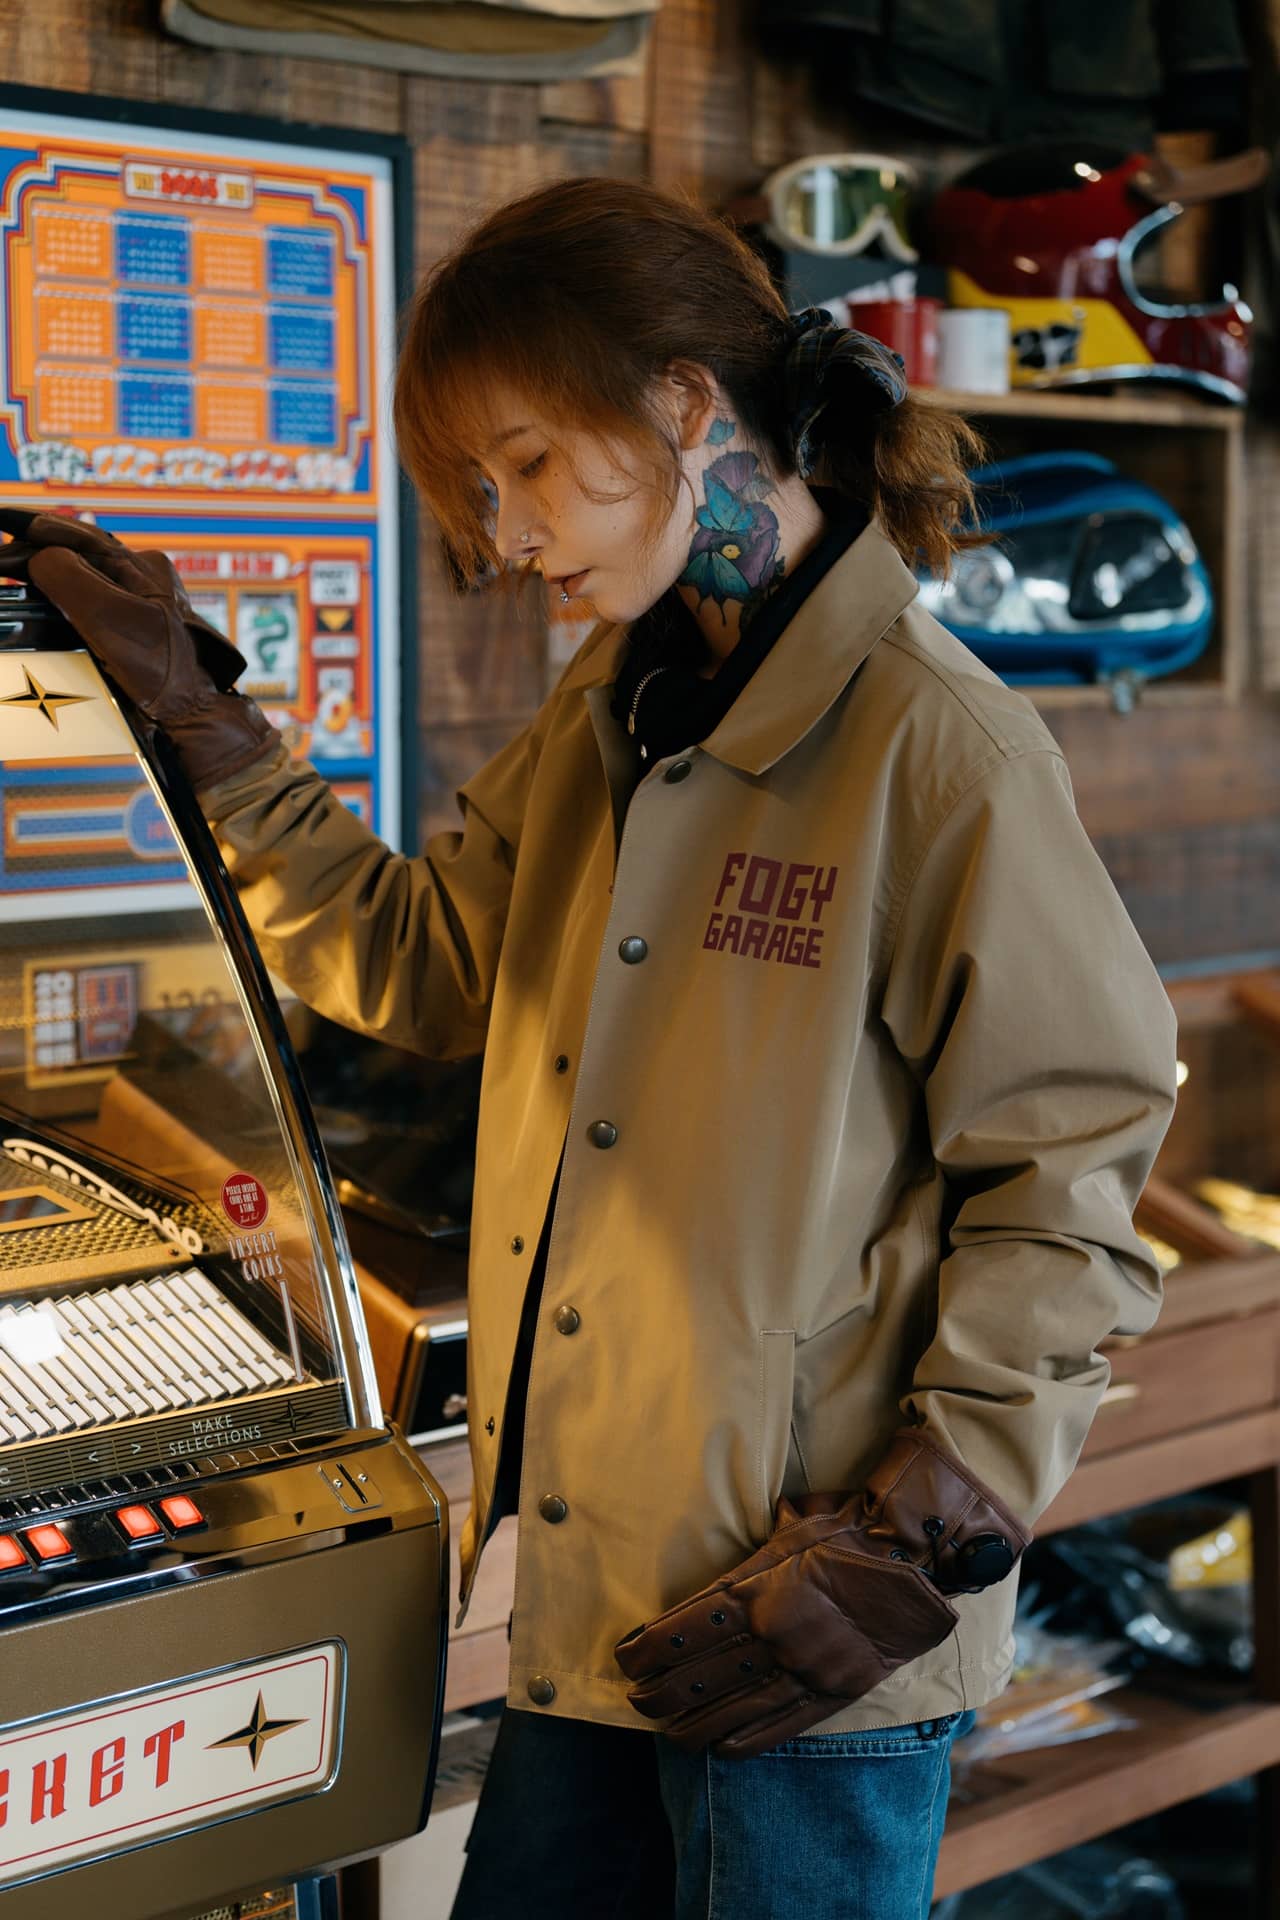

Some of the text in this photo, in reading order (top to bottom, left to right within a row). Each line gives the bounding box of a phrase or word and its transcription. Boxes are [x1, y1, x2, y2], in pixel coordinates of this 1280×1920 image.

[714, 853, 838, 923] FOGY
[703, 912, 824, 969] GARAGE
[225, 1182, 257, 1196] PLEASE INSERT
[228, 1231, 277, 1260] INSERT
[243, 1255, 283, 1281] COINS
[191, 1414, 234, 1435] MAKE
[168, 1425, 262, 1456] SELECTIONS
[0, 1720, 185, 1828] KET
